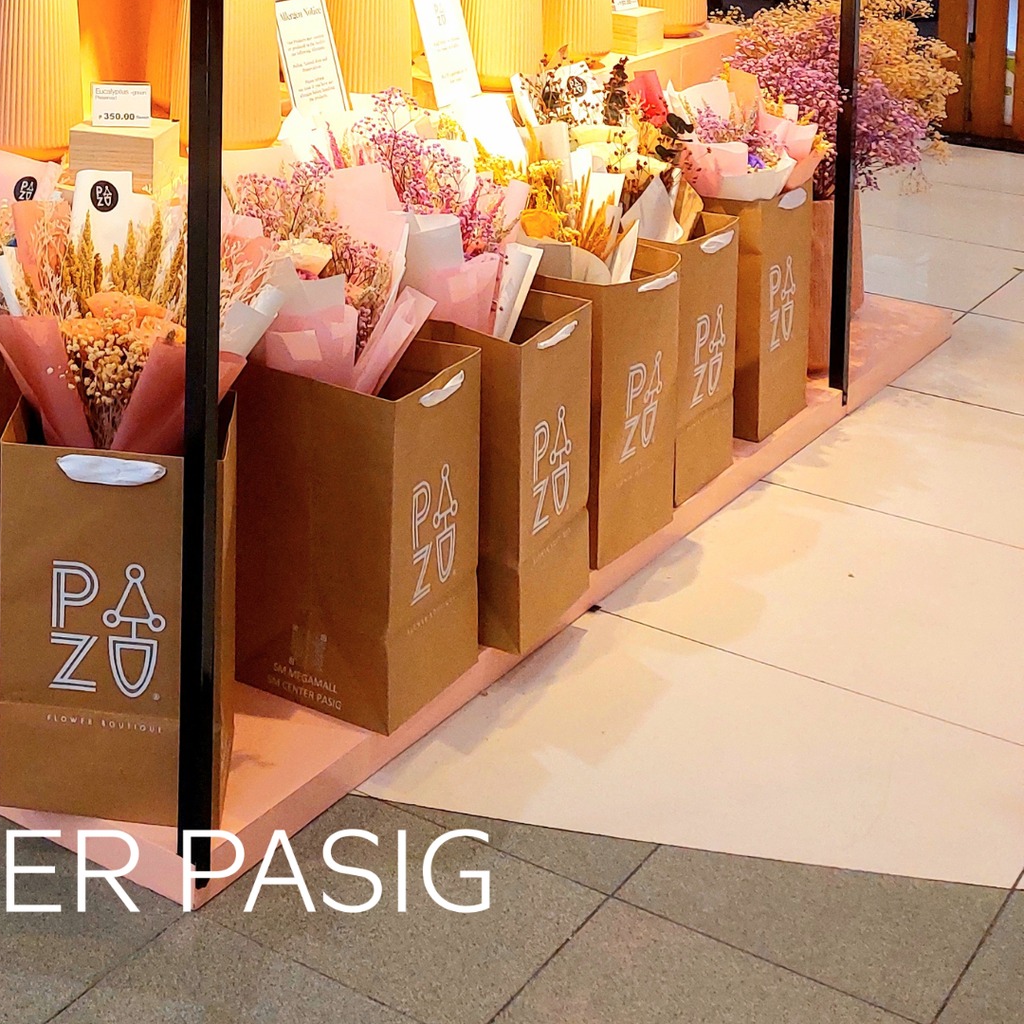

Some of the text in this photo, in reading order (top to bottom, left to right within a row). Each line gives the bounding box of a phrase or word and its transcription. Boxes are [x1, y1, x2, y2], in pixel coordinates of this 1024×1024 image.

[103, 112, 135, 121] 350.00
[282, 680, 315, 700] CENTER
[316, 693, 342, 711] PASIG
[46, 714, 163, 734] FLOWER BOUTIQUE
